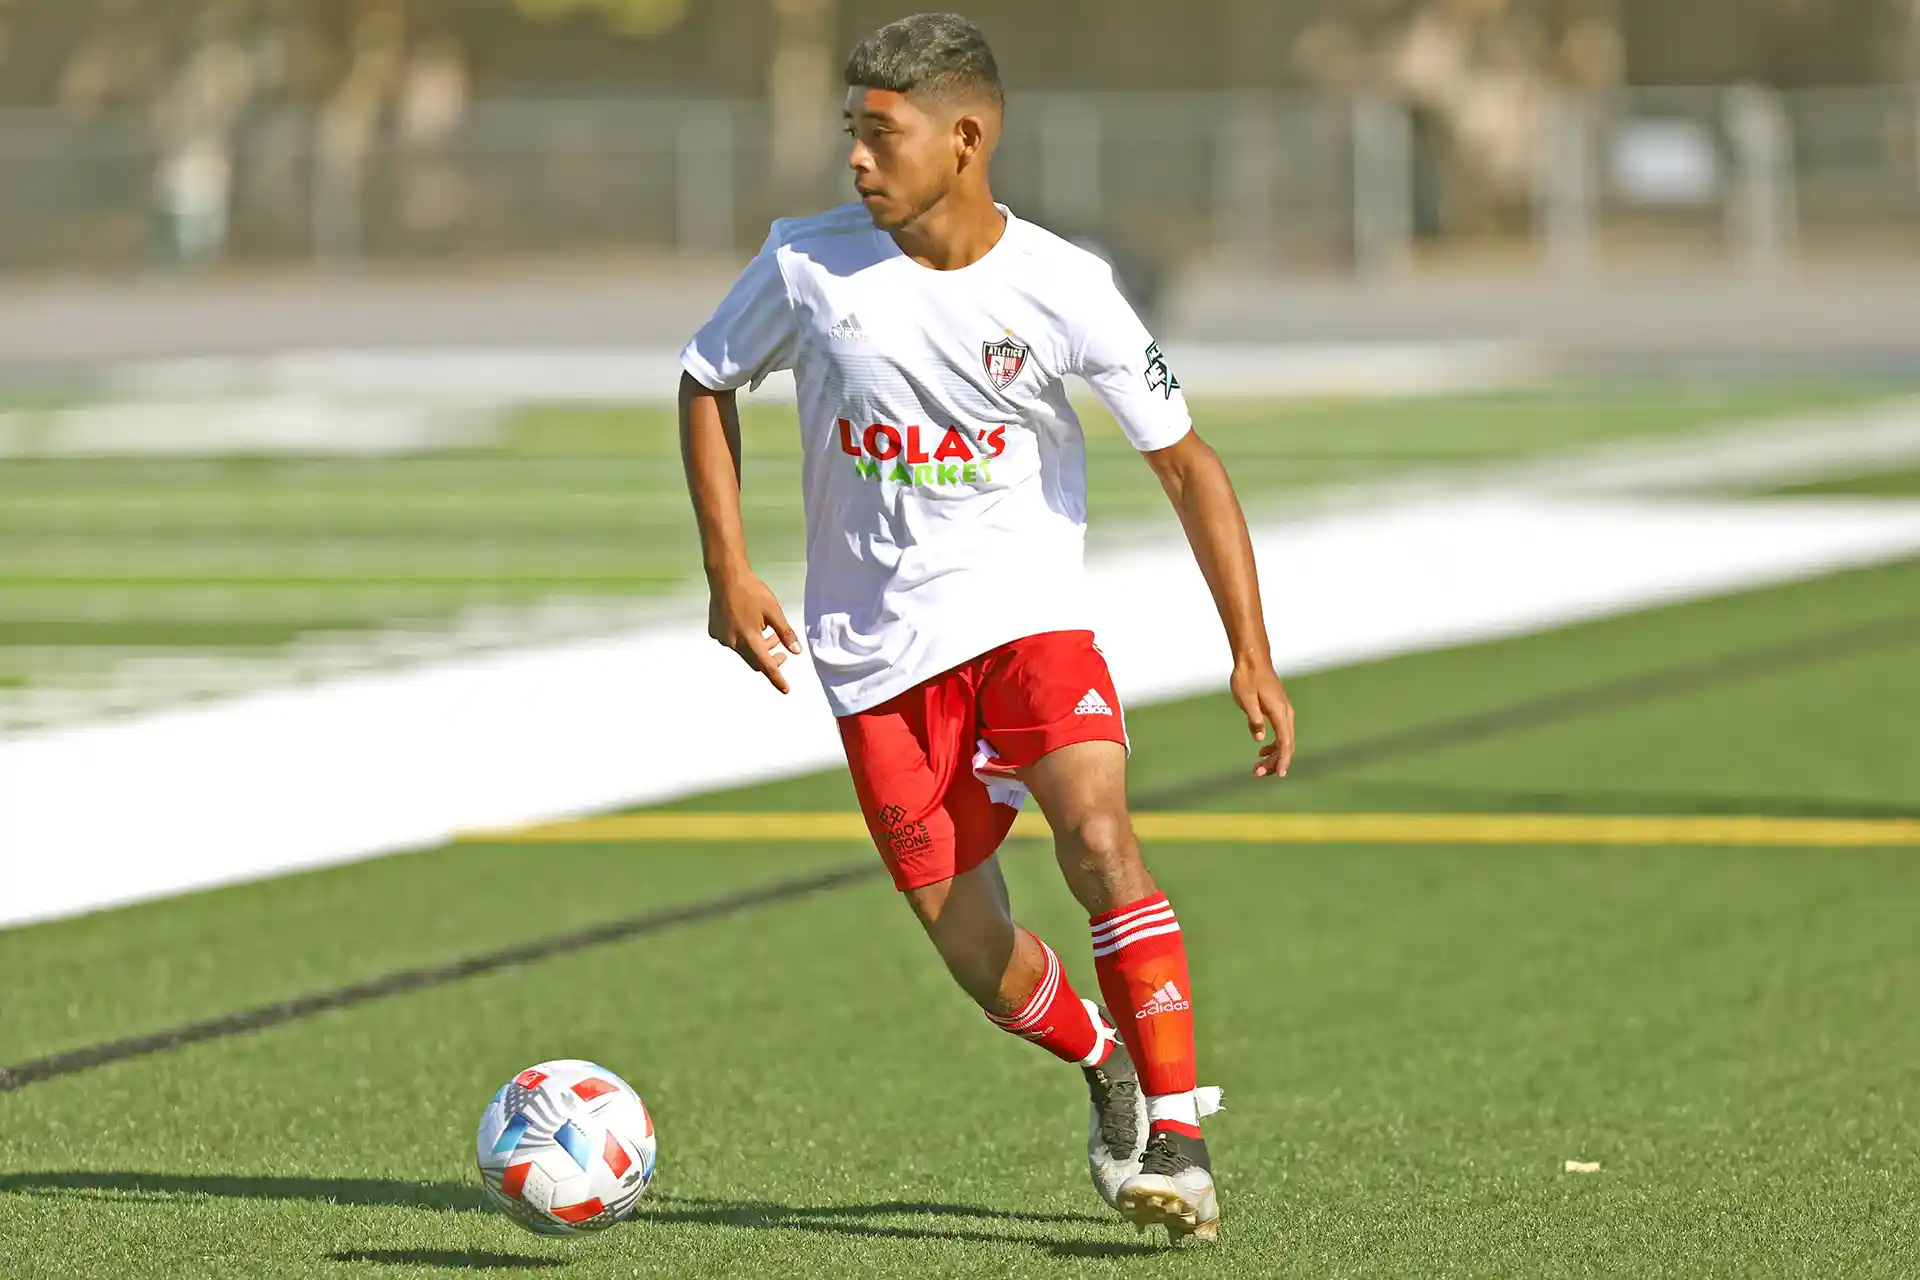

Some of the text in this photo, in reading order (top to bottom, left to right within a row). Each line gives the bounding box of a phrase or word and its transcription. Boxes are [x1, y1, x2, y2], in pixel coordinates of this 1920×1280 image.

[838, 418, 1006, 464] LOLA'S
[855, 458, 992, 486] MARKET
[1074, 705, 1112, 716] adidas
[893, 832, 931, 851] STONE
[1135, 1000, 1189, 1019] adidas
